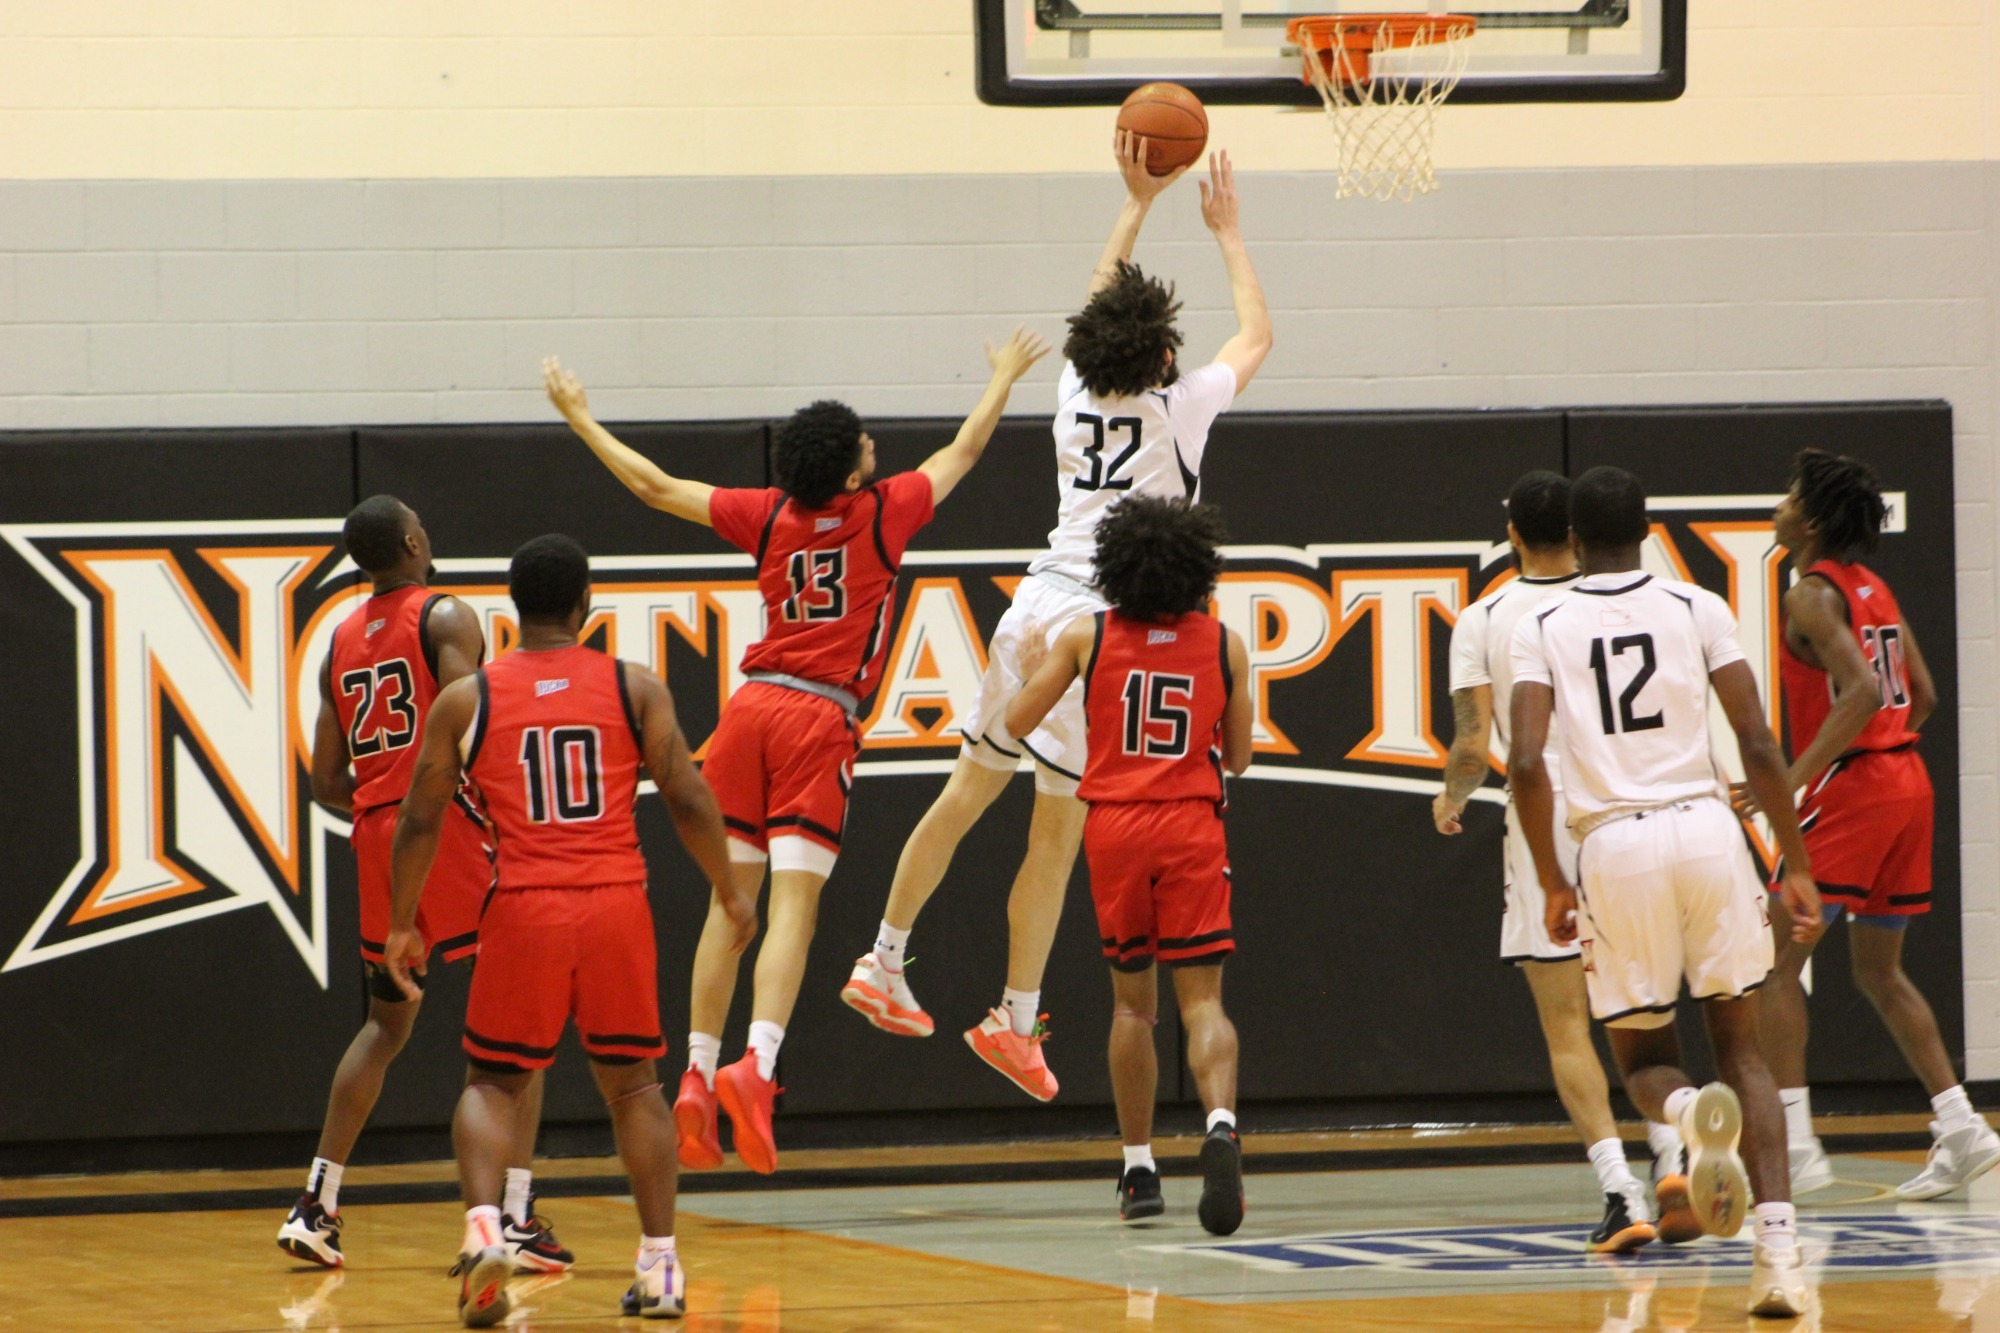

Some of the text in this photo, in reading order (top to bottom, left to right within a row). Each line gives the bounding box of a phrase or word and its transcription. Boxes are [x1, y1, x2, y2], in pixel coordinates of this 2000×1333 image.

[1072, 411, 1143, 492] 32
[781, 546, 848, 623] 13
[341, 657, 417, 760] 23
[1120, 669, 1195, 760] 15
[1588, 632, 1664, 735] 12
[518, 725, 605, 824] 10
